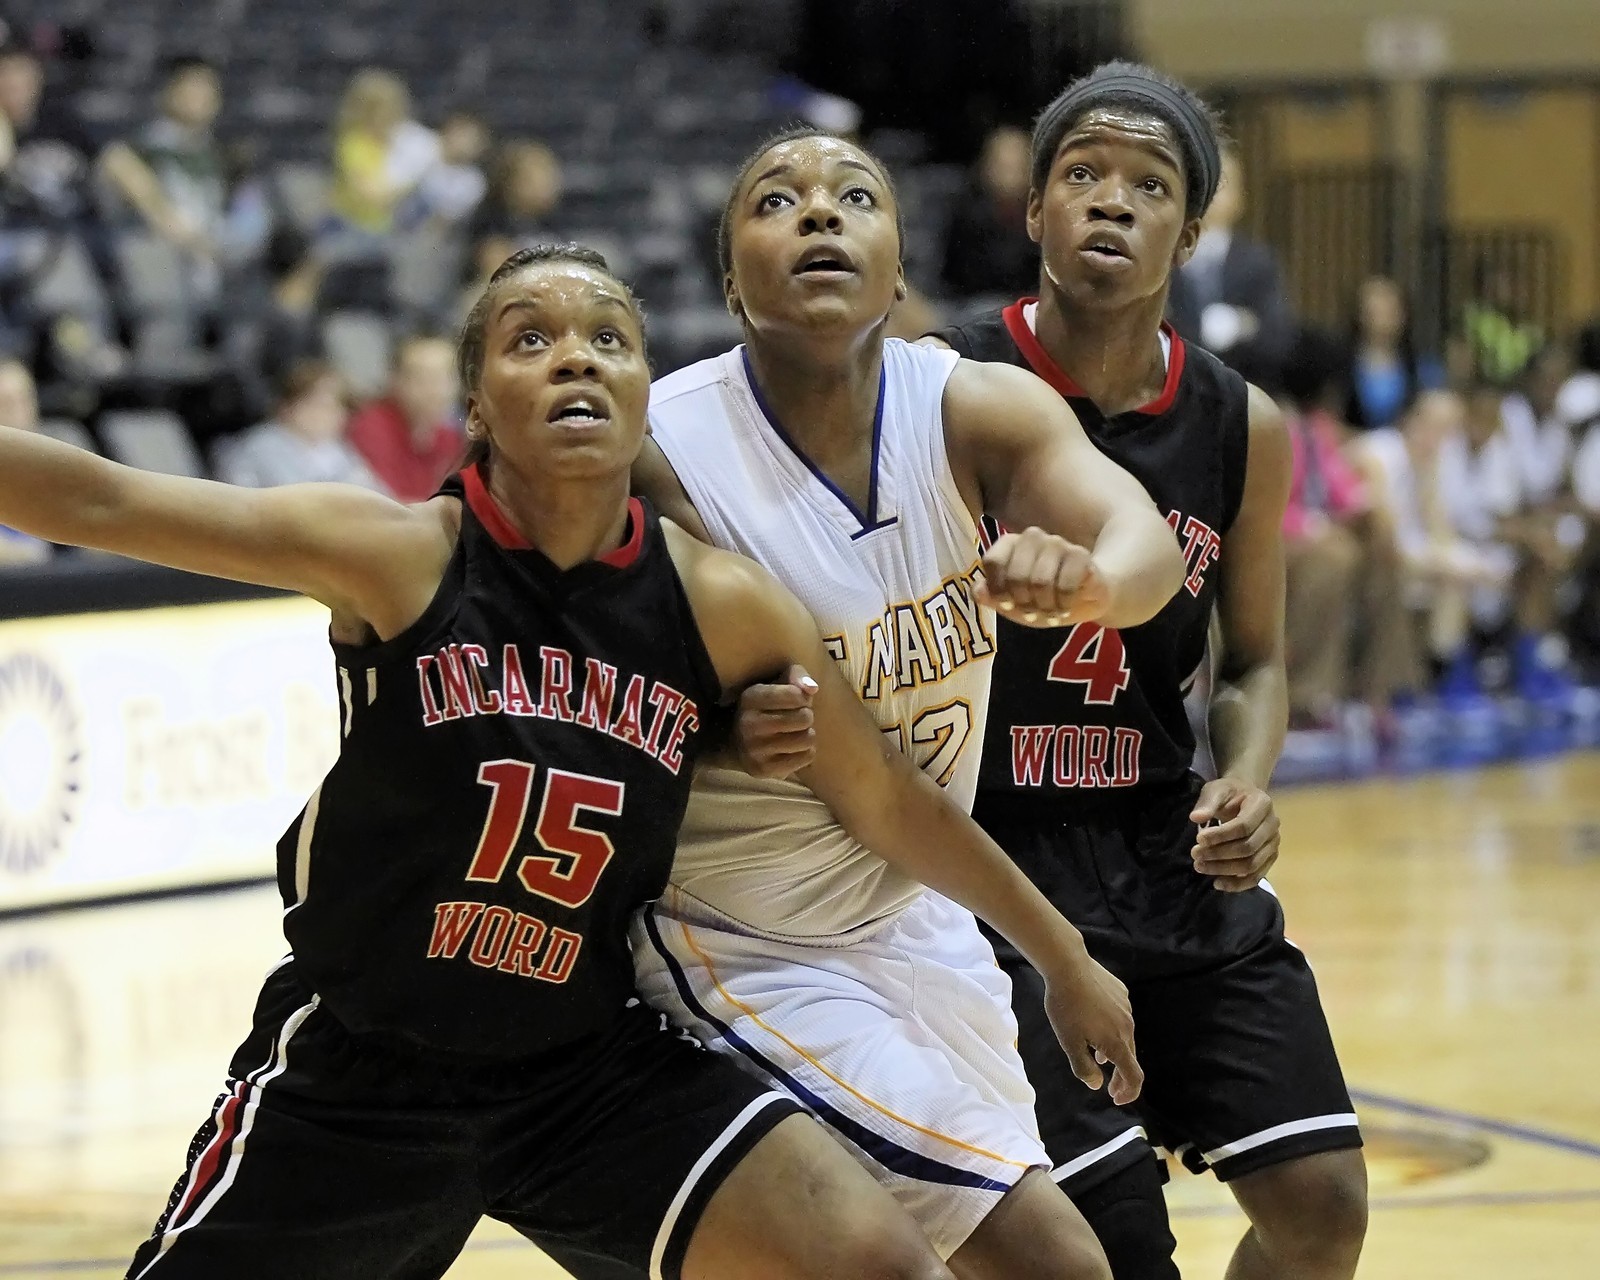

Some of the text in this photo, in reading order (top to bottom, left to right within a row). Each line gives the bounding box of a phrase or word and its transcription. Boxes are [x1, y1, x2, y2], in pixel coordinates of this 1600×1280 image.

[1047, 621, 1131, 706] 4
[416, 642, 700, 776] INCARNATE
[1010, 724, 1143, 788] WORD
[465, 758, 625, 909] 15
[427, 901, 583, 984] WORD
